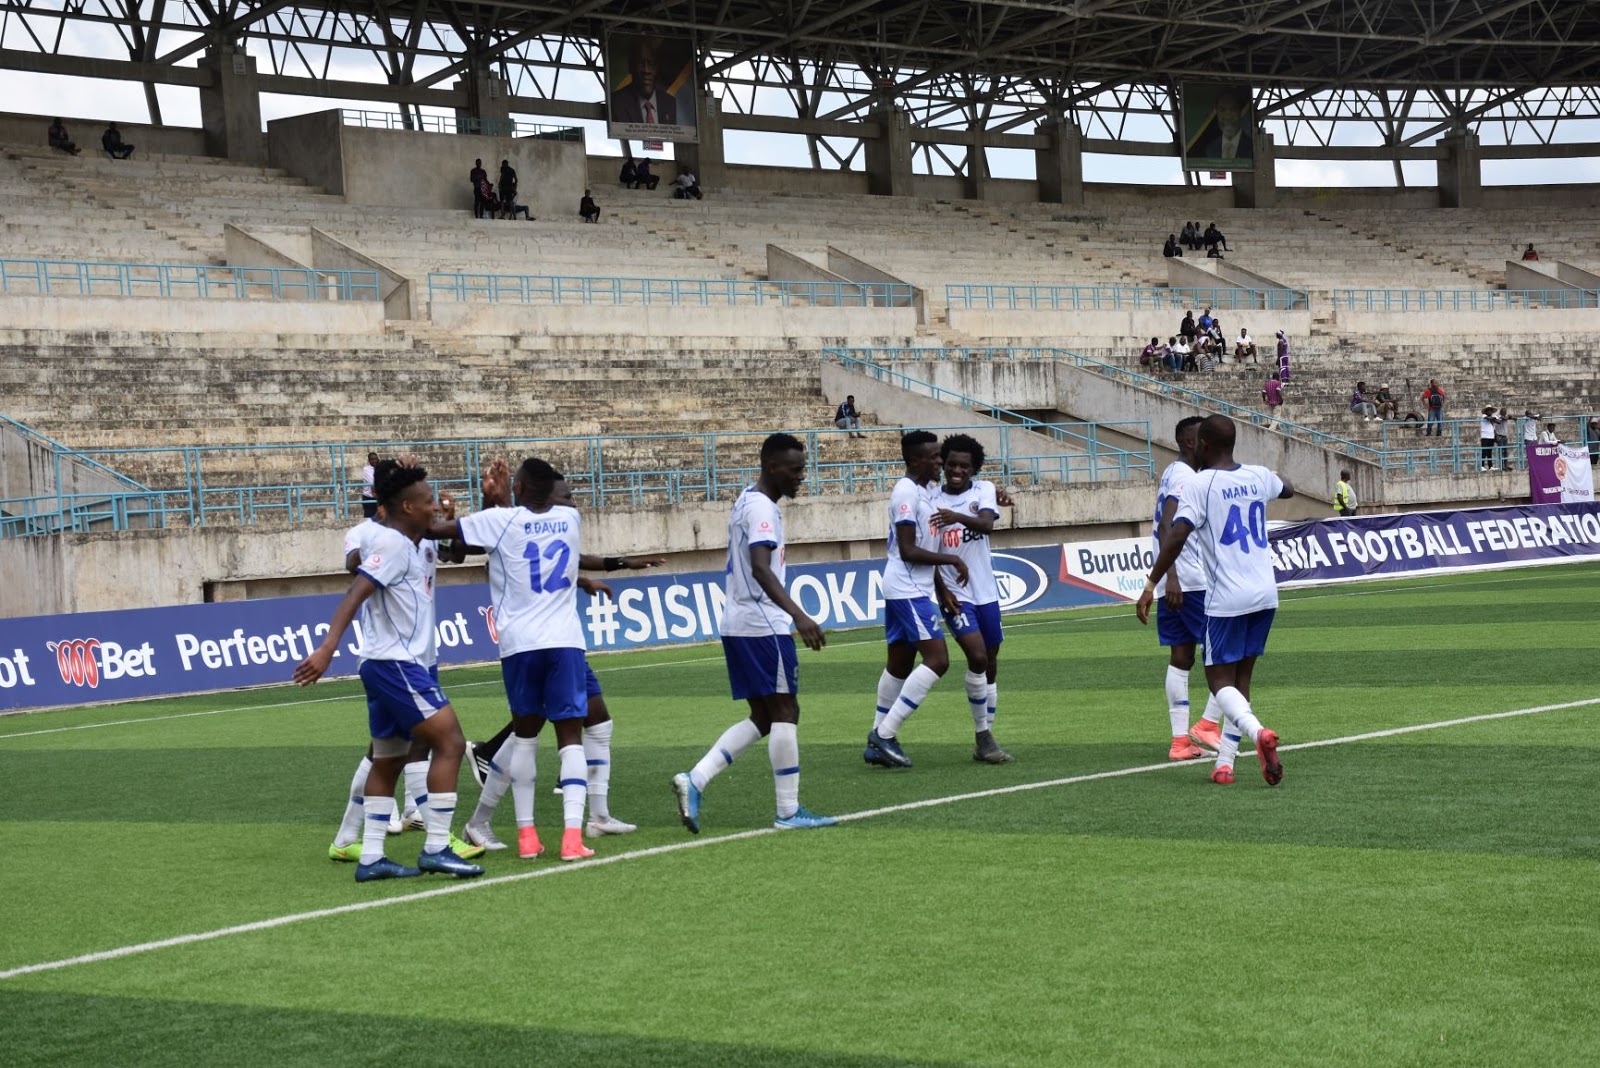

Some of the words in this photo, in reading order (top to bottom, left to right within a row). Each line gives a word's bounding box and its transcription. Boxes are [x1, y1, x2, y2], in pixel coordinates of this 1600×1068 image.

[1221, 485, 1248, 500] MAN
[1250, 484, 1258, 495] U
[1219, 500, 1268, 555] 40
[1268, 533, 1332, 571] ANIA
[1327, 524, 1471, 566] FOOTBALL
[1466, 512, 1600, 553] FEDERATIO
[523, 539, 572, 594] 12
[1078, 544, 1154, 575] Buruda
[0, 648, 36, 688] ot
